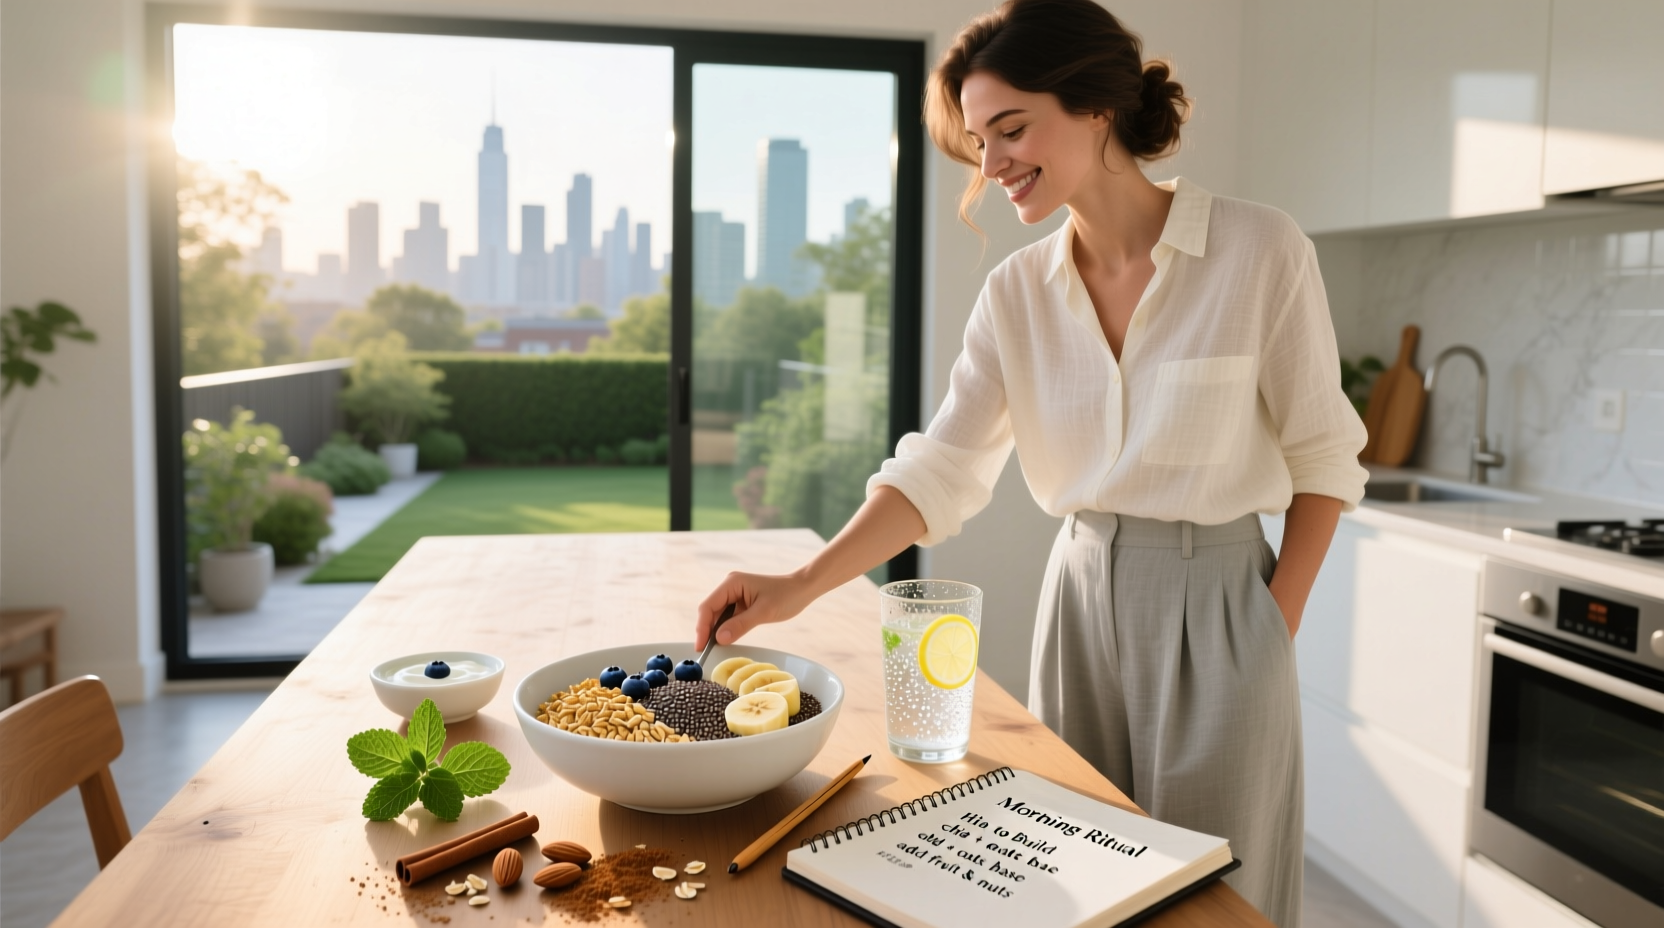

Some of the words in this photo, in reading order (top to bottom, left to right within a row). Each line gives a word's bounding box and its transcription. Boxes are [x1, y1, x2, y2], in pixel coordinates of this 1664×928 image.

[996, 797, 1082, 836] Morning
[1083, 829, 1148, 858] Ritual
[896, 842, 929, 859] add
[961, 868, 975, 882] &
[977, 878, 1014, 899] nuts
